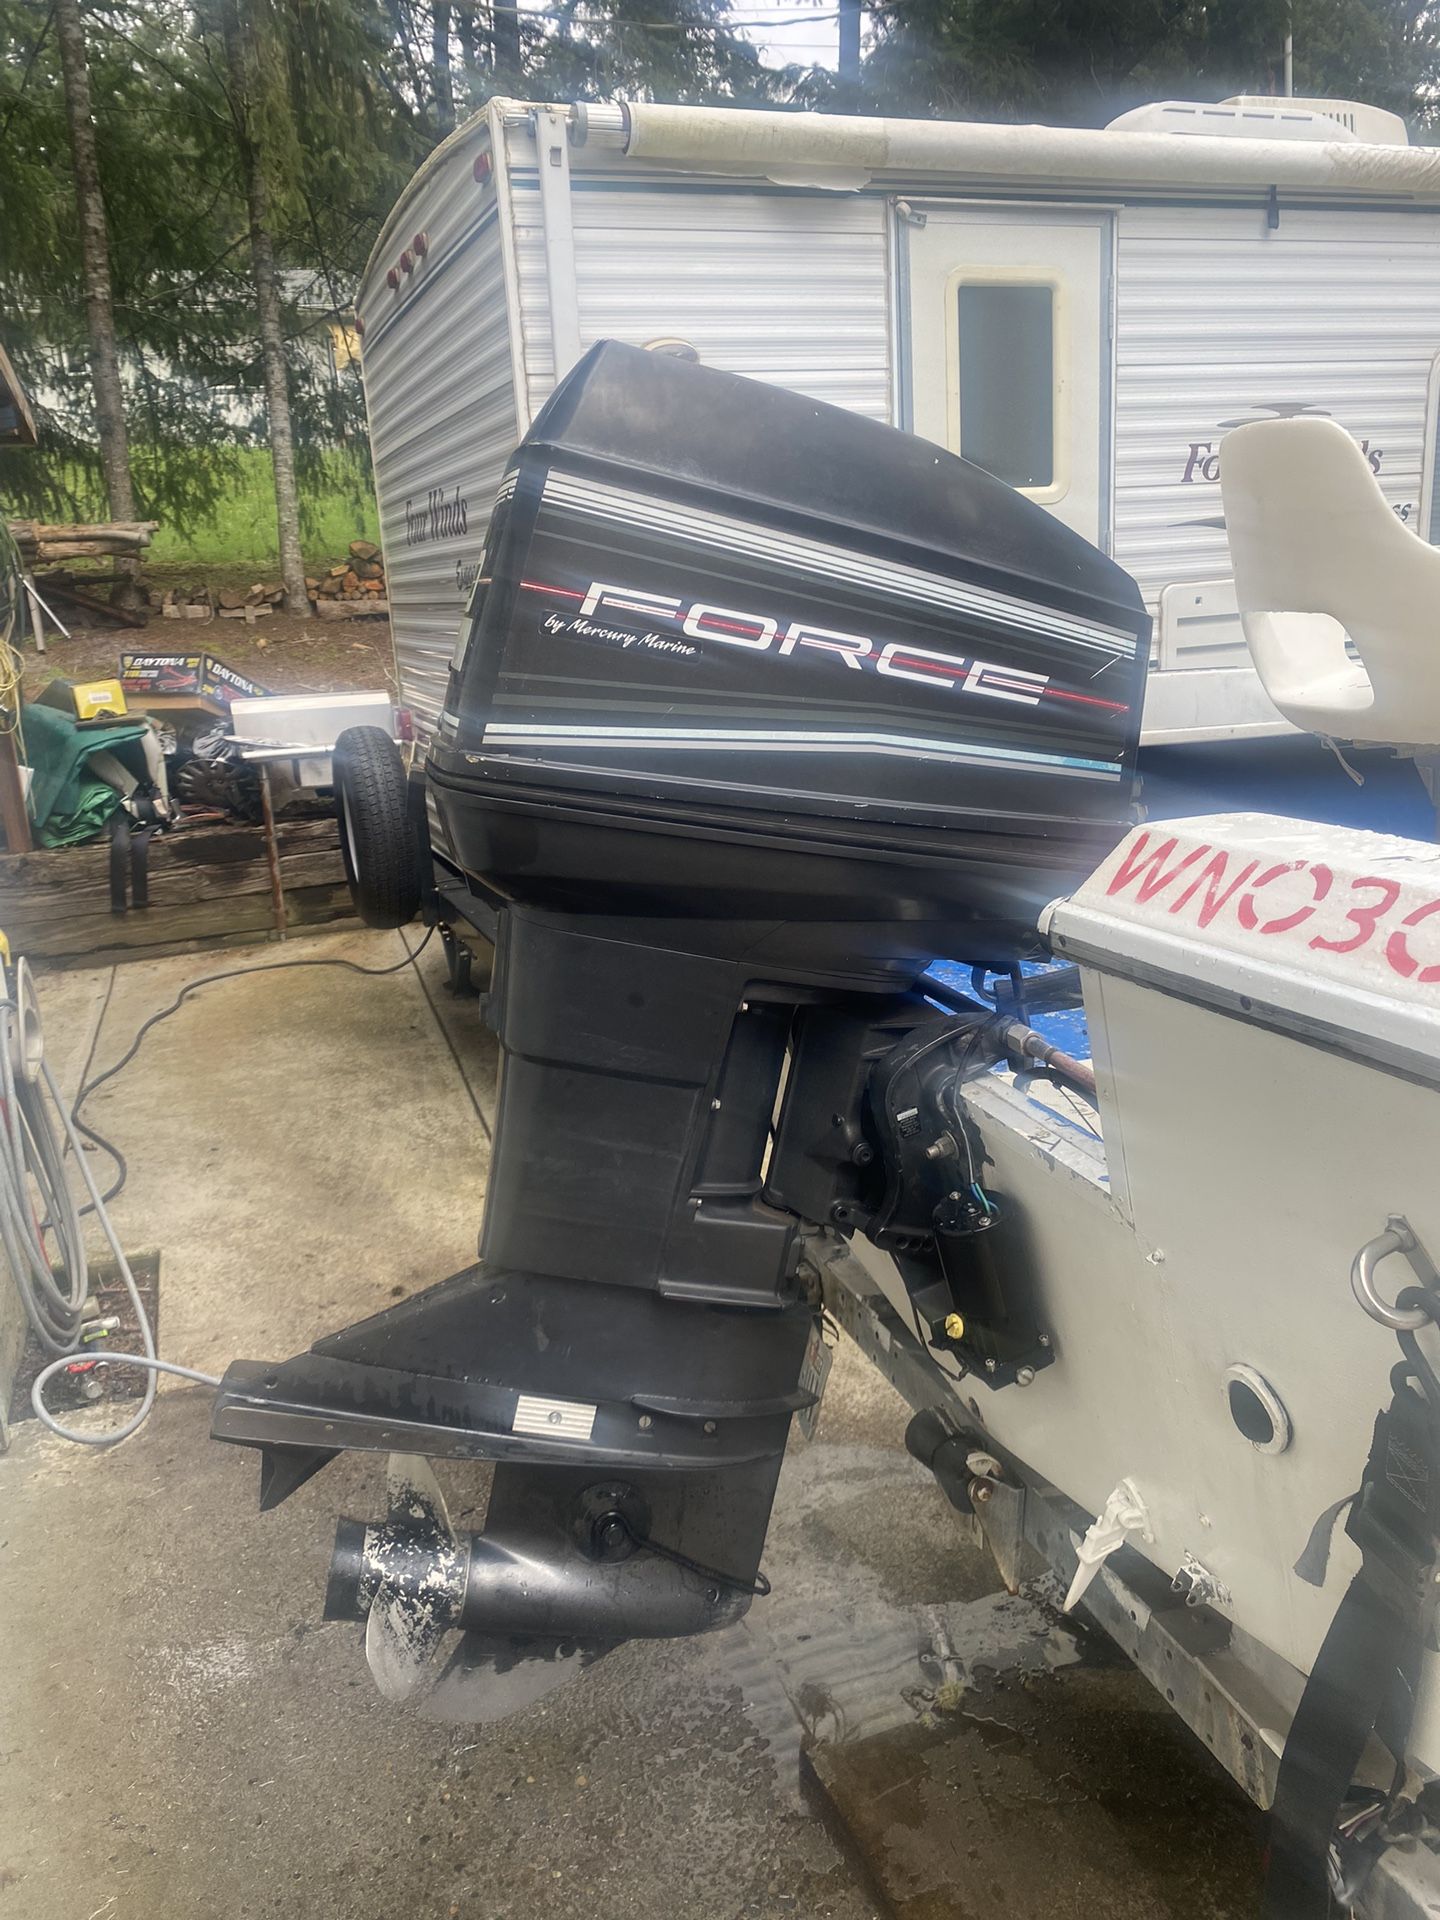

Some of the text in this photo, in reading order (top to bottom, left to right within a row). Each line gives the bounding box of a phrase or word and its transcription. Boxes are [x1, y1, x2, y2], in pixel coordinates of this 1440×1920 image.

[1181, 442, 1220, 482] Fo
[428, 486, 467, 541] Winds
[544, 613, 696, 656] by Mercury Marine
[579, 581, 1050, 705] FORCE
[132, 657, 185, 666] DAYTONA
[212, 663, 254, 693] DAYTONA
